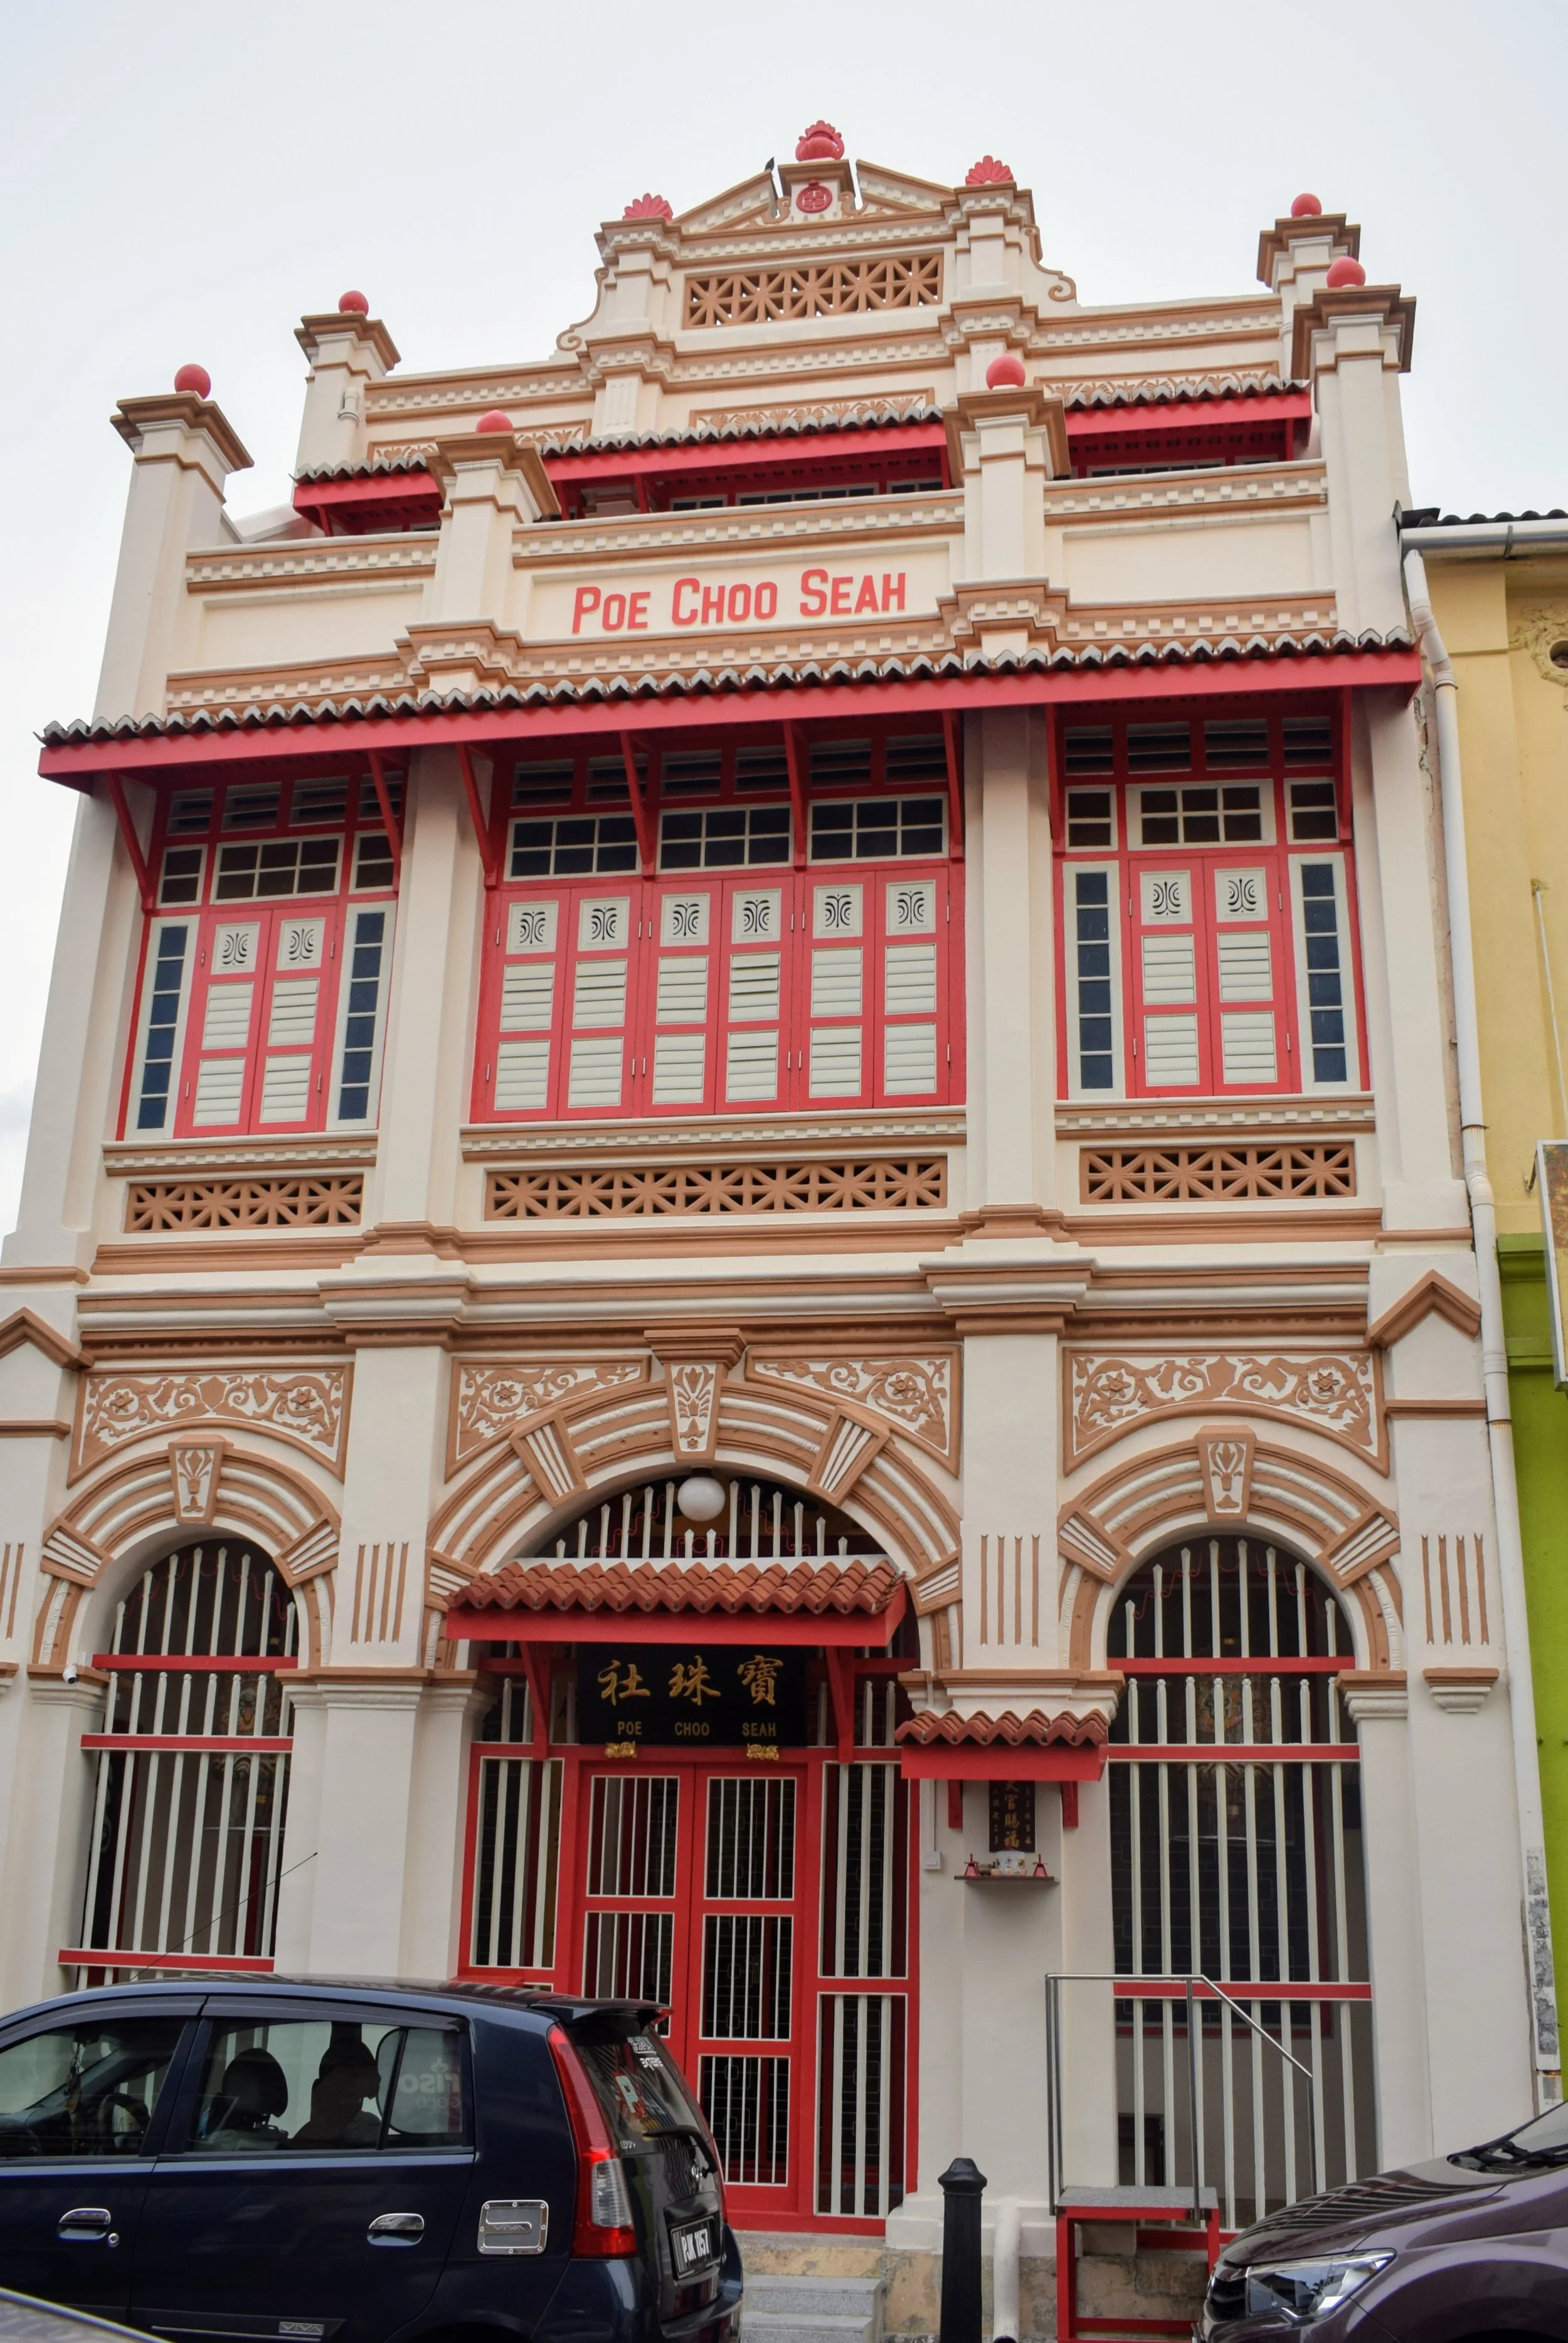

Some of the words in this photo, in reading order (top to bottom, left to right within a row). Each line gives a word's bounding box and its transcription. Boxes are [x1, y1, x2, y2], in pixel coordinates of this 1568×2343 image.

[571, 586, 651, 634] POE
[671, 578, 778, 625] CHOO
[800, 569, 906, 616] SEAH
[617, 1721, 642, 1735] POE
[675, 1722, 710, 1737] CHOO
[742, 1723, 776, 1737] SEAH
[615, 2075, 638, 2113] P
[681, 2233, 696, 2263] PJK
[694, 2228, 710, 2257] 1157
[280, 2323, 323, 2334] VIVA
